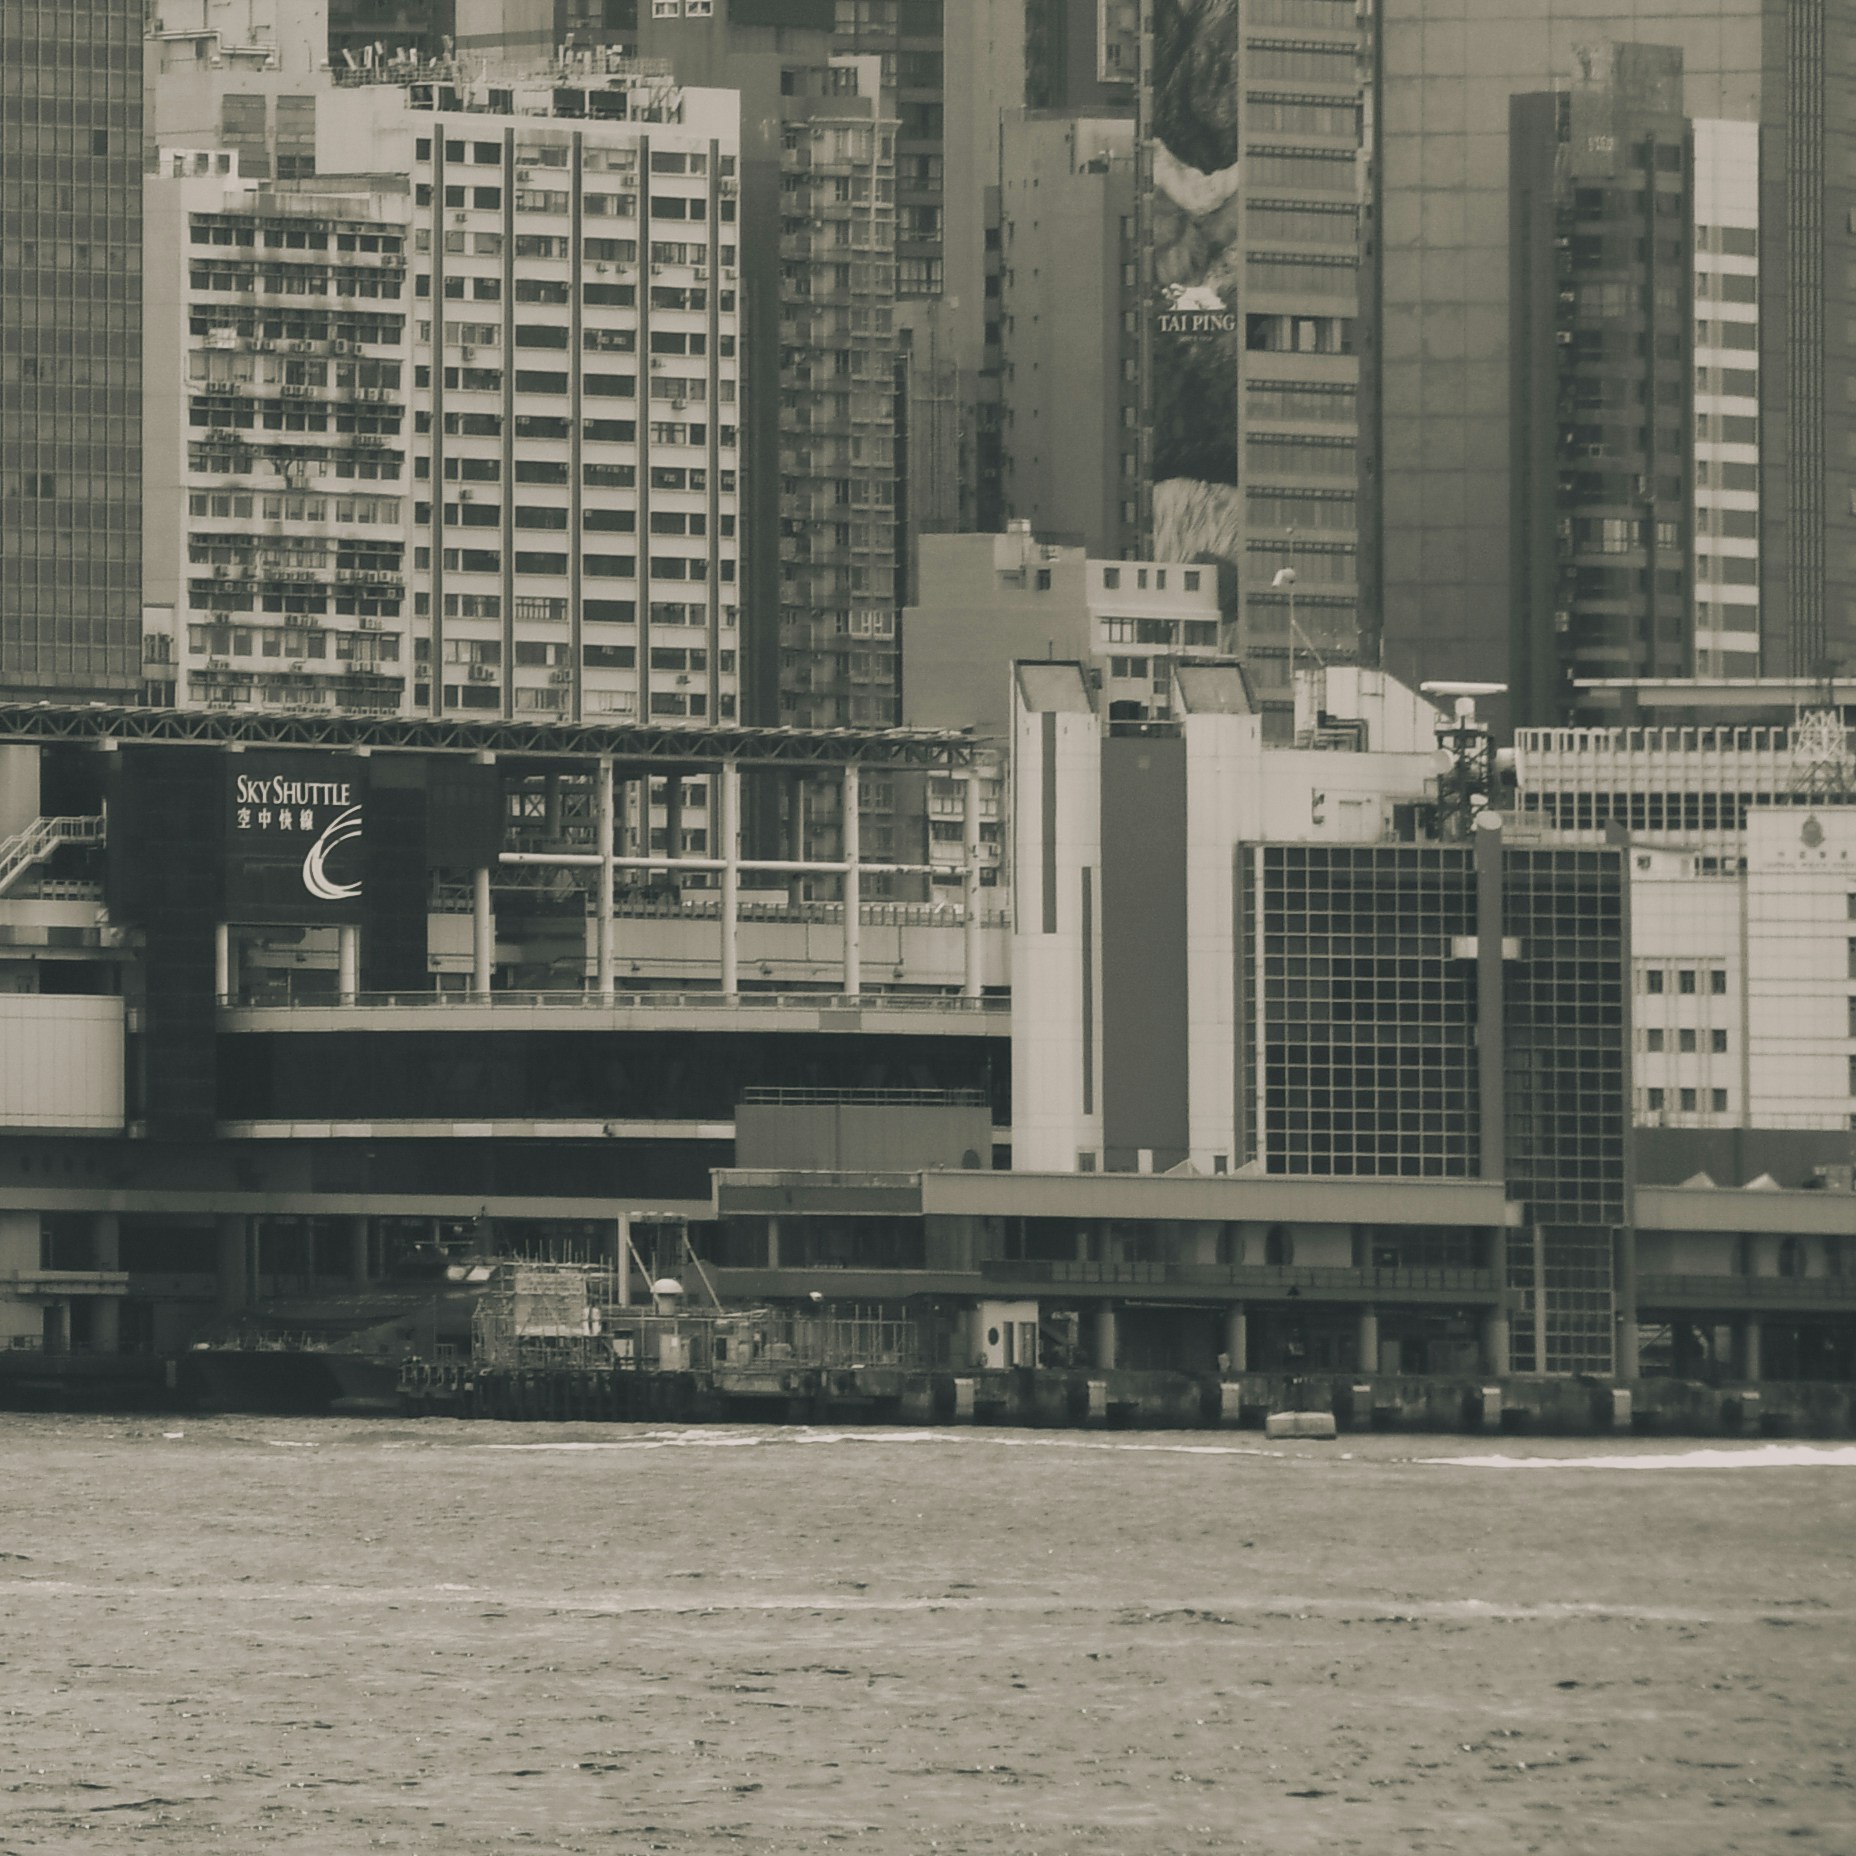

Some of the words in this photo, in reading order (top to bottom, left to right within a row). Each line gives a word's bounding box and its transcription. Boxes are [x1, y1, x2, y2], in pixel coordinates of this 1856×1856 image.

[1157, 314, 1187, 332] TAI
[1192, 314, 1237, 332] PING
[236, 807, 314, 831] 空中快線
